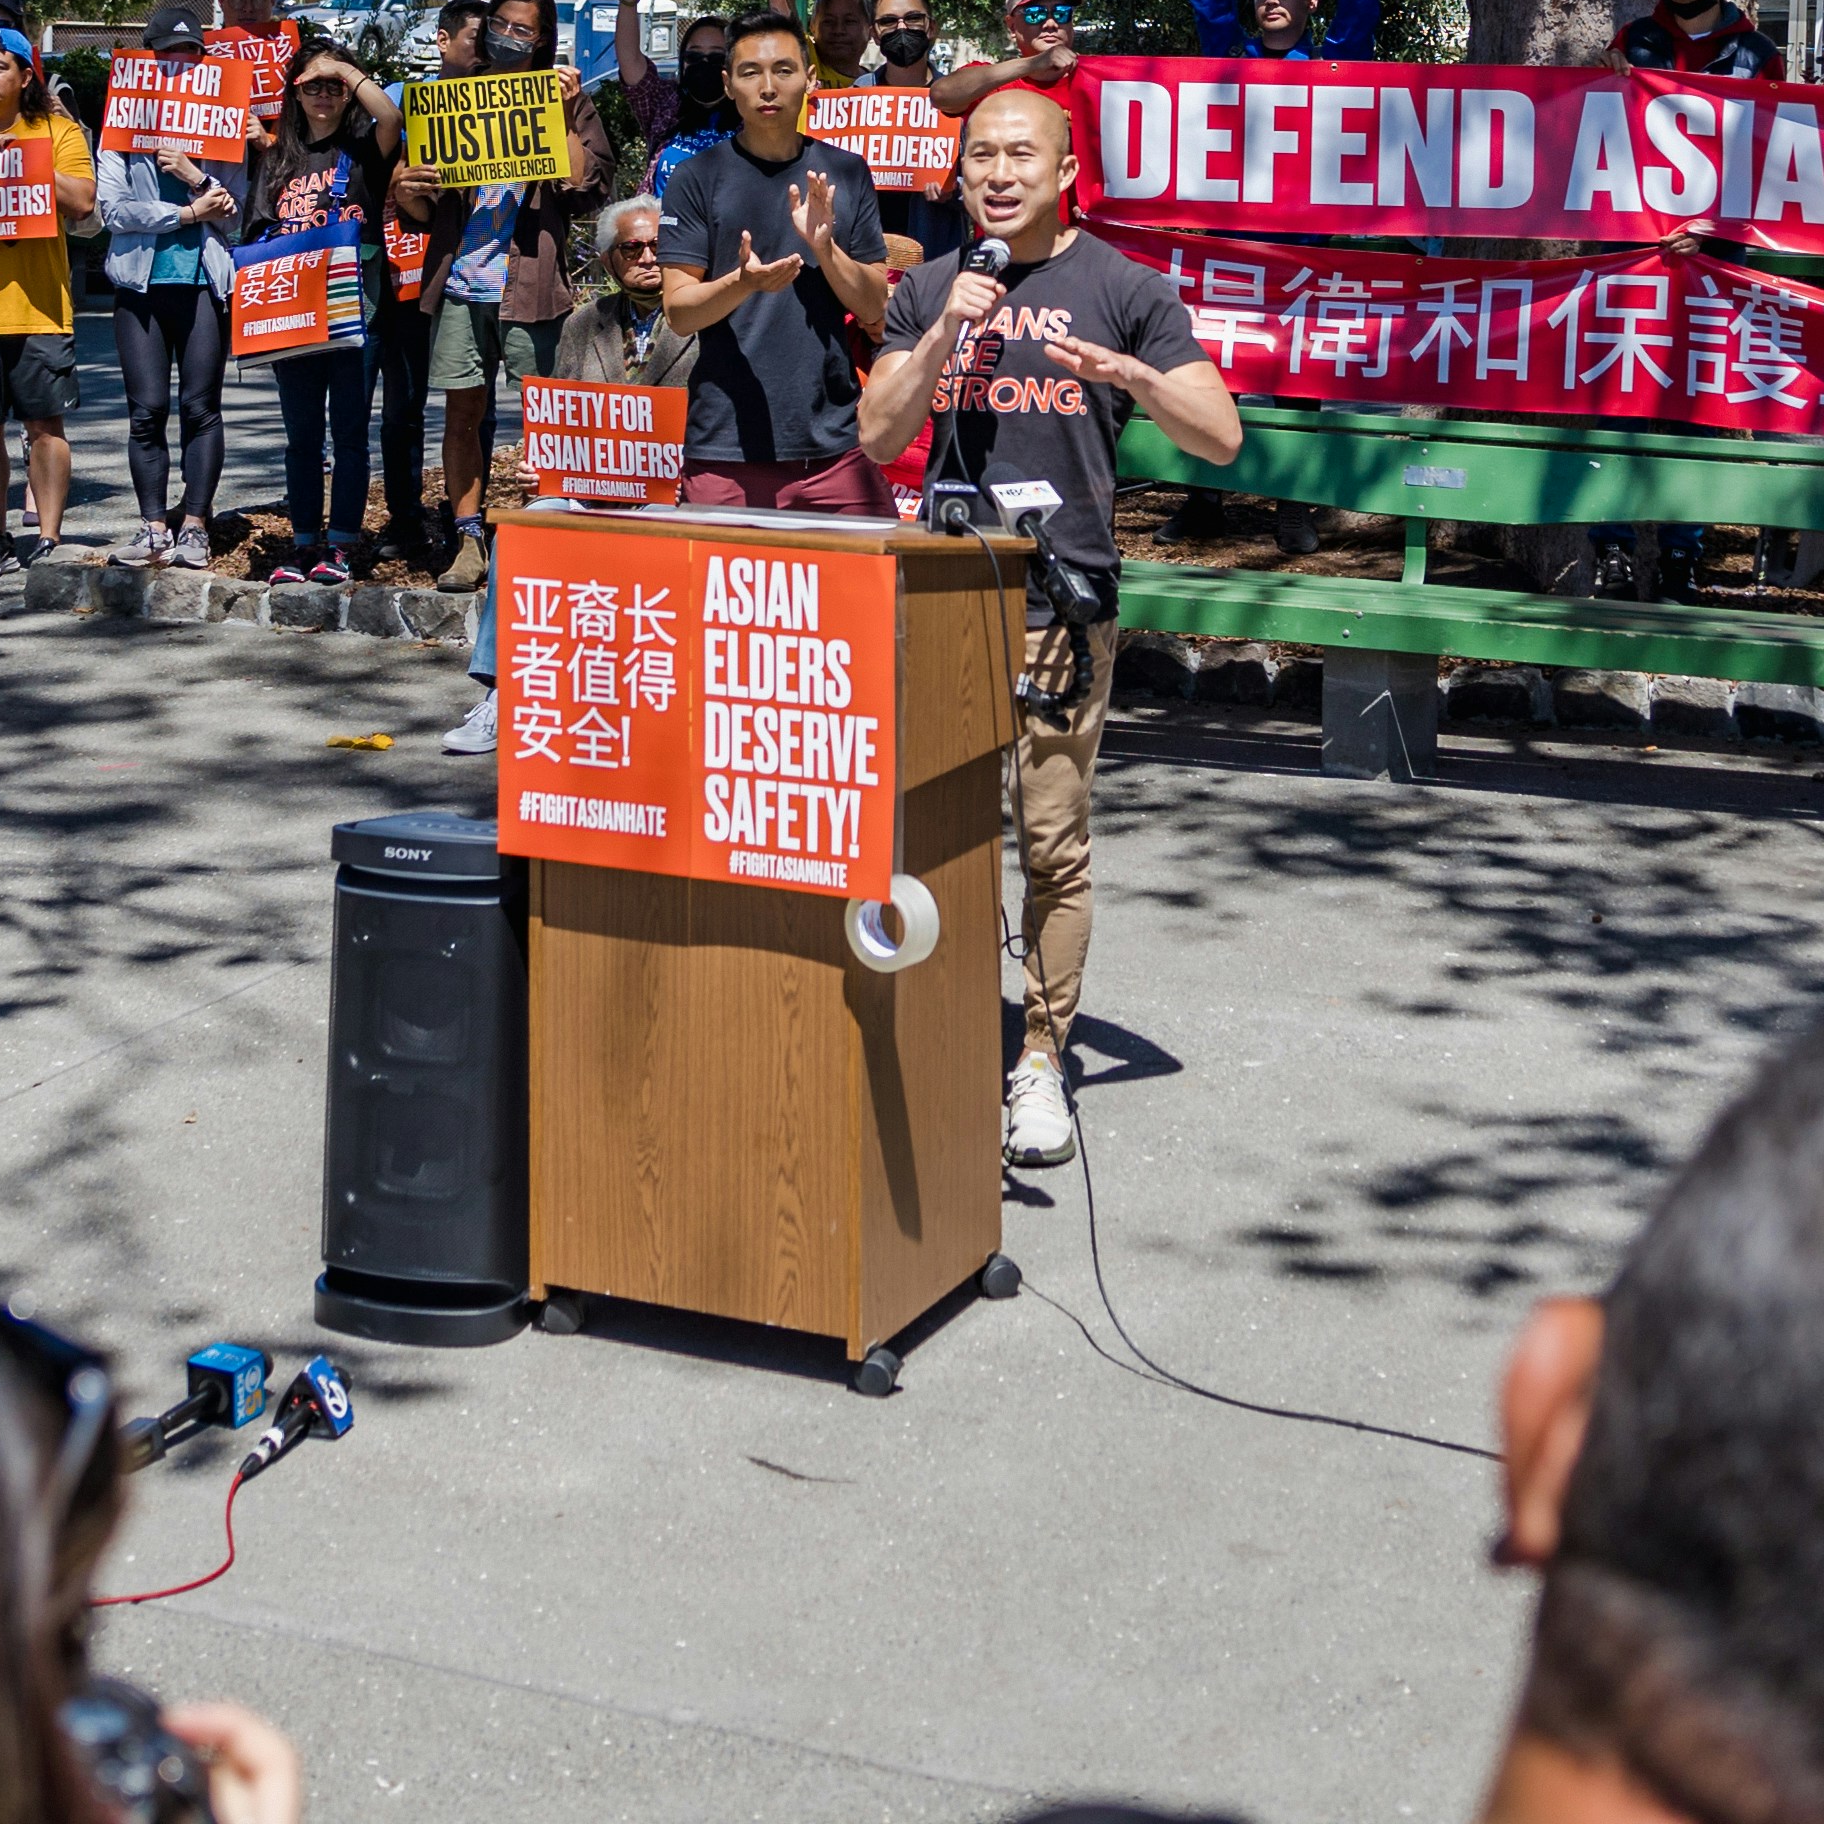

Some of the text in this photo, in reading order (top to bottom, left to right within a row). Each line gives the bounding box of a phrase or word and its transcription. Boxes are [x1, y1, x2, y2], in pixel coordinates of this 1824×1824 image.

[111, 57, 179, 93] SAFETY
[179, 61, 222, 97] FOR
[409, 74, 559, 117] ASIANS DESERVE
[105, 96, 245, 140] ASIAN ELDERS!
[809, 94, 939, 130] JUSTICE FOR
[419, 107, 551, 165] JUSTICE
[867, 135, 955, 169] ELDERS!
[1099, 79, 1537, 210] DEFEND
[278, 167, 337, 205] ASIAN
[438, 157, 557, 184] WILLNOTBESILENCED
[279, 194, 319, 219] ARE
[240, 274, 299, 309] 安全!
[243, 311, 316, 337] #FIGHTASIANHATE
[968, 306, 1073, 341] ANS
[526, 385, 654, 433] SAFETY FOR
[932, 377, 1088, 415] STRONG.
[528, 432, 685, 480] ASIAN ELDERS!
[562, 477, 648, 499] #FIGHTASIANHATE
[511, 576, 678, 647] 亚裔长
[702, 555, 819, 632] ASIAN
[511, 637, 677, 712] 者值得
[703, 627, 852, 709] ELDERS
[513, 701, 631, 769] 安全!
[703, 701, 879, 786] DESERVE
[519, 790, 667, 839] #FIGHTASIANHATE
[703, 773, 861, 858] SAFETY!
[384, 846, 433, 861] SONY
[729, 850, 848, 890] #FIGHTASIANHATE
